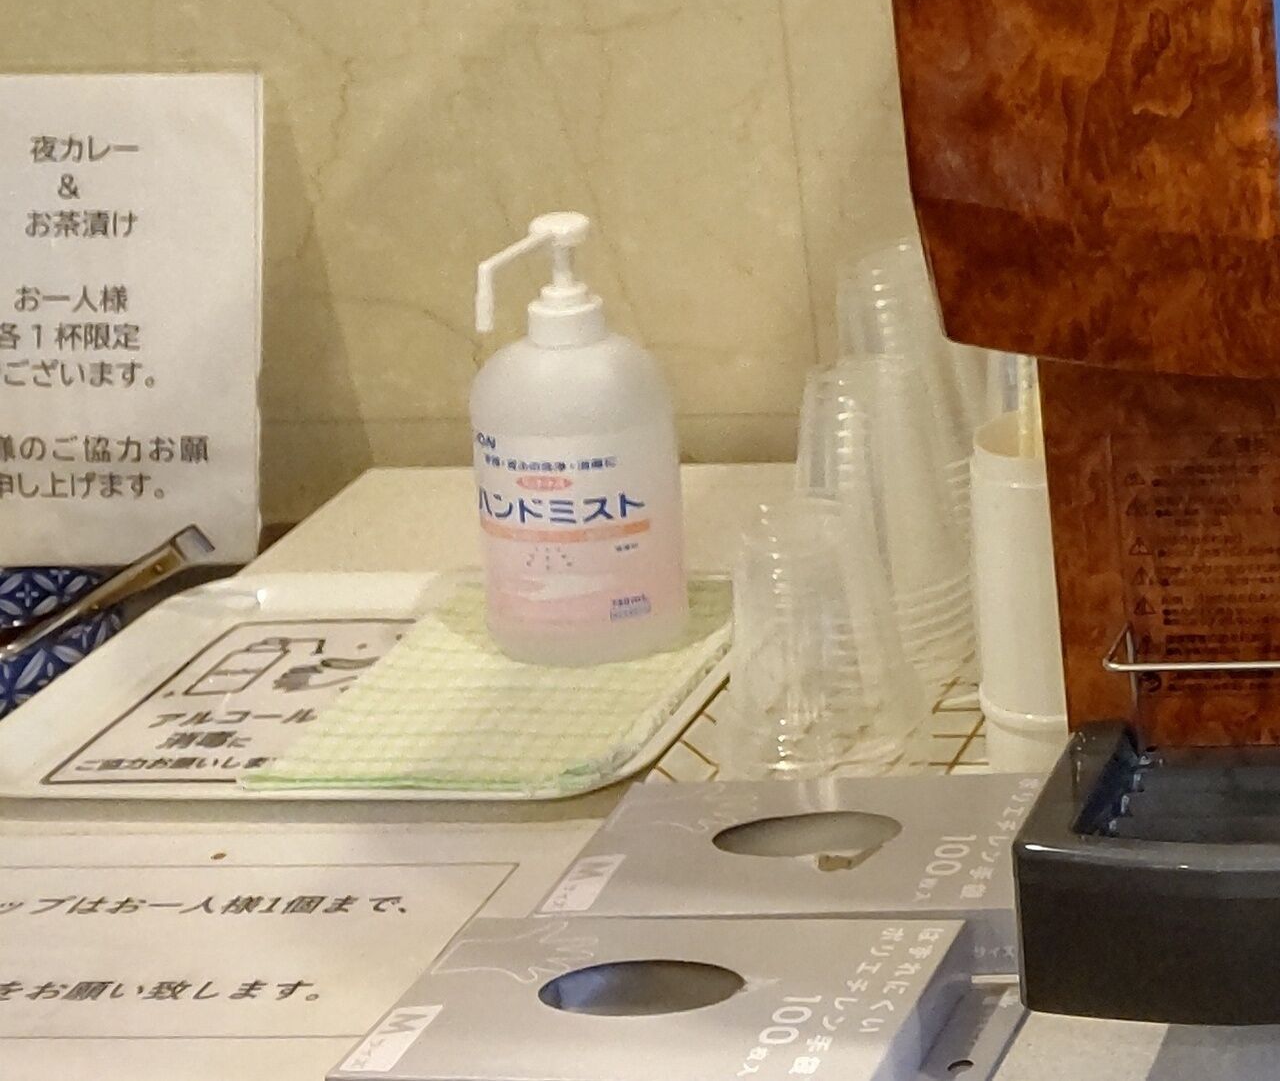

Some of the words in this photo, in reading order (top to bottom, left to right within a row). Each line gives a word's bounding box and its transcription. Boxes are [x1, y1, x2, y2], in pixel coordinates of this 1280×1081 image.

[29, 135, 140, 164] 夜カレー
[57, 173, 81, 200] &
[25, 210, 139, 238] お茶漬け
[14, 284, 129, 313] お一人様
[3, 359, 156, 388] ございます。
[479, 485, 646, 524] ハンドミスト
[147, 708, 319, 728] アルコール
